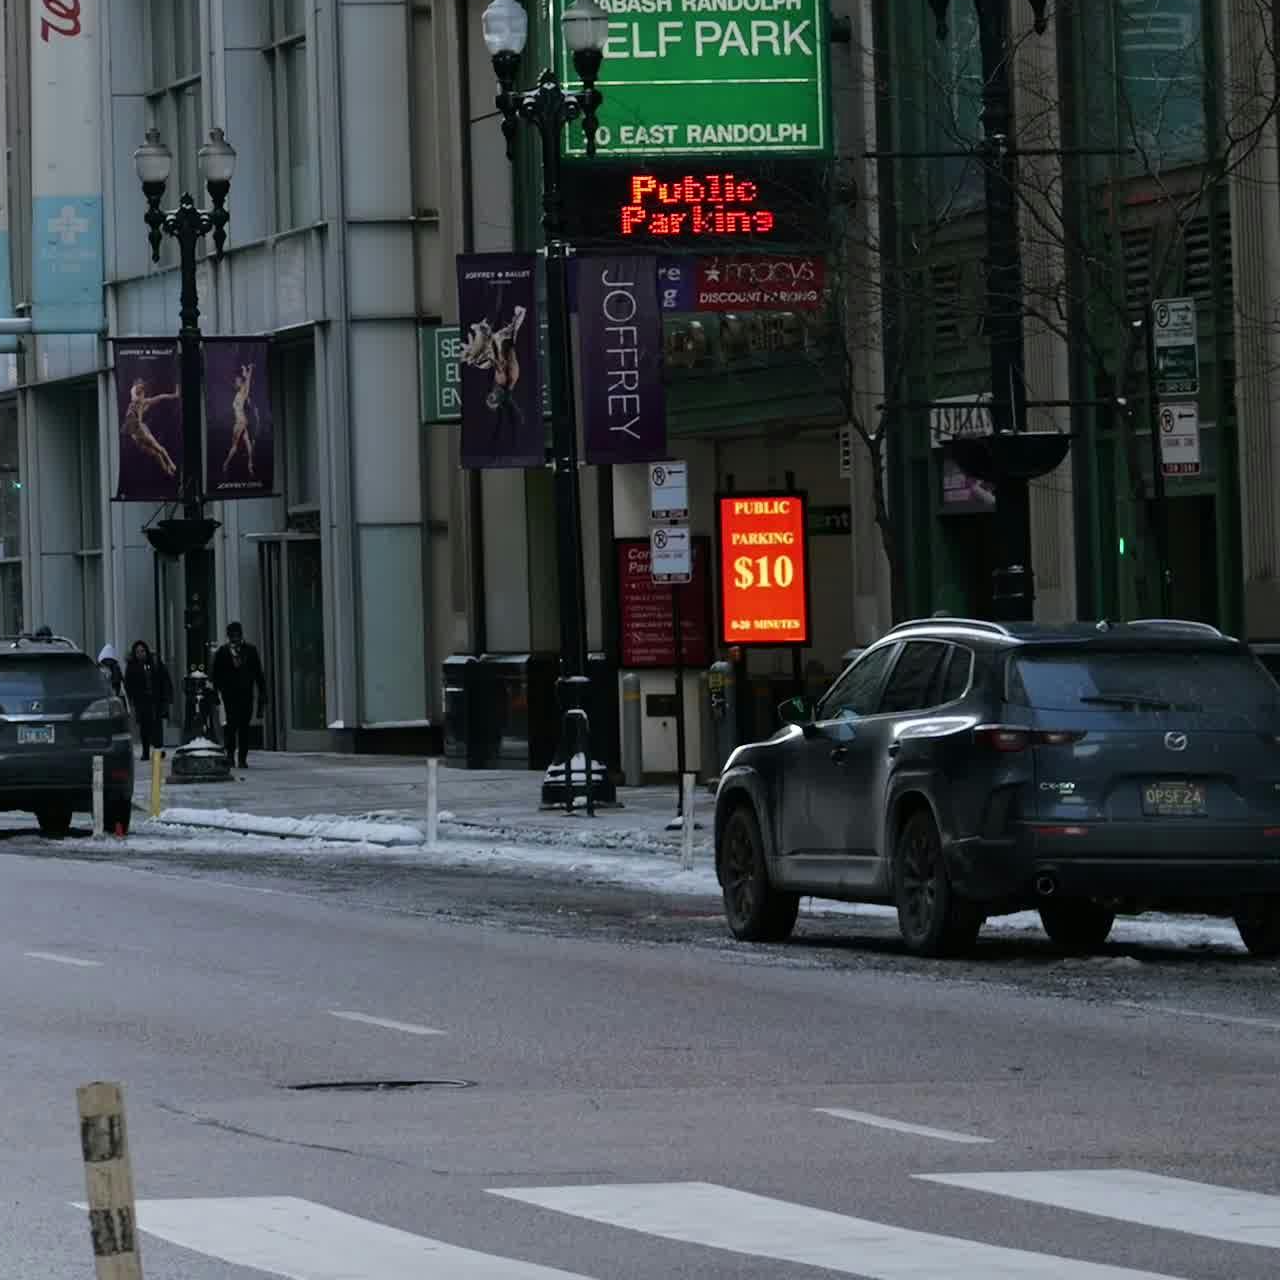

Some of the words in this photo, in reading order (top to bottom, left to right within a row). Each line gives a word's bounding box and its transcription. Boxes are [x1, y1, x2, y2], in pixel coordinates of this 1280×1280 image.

[602, 21, 684, 59] ELF
[694, 20, 813, 58] PARK
[619, 124, 679, 145] EAST
[686, 123, 808, 144] RANDOLPH
[631, 175, 757, 204] Public
[620, 204, 775, 235] Parking
[699, 289, 761, 304] DISCOUNT
[601, 269, 641, 440] JOFFREY
[734, 500, 790, 515] PUBLIC
[731, 531, 795, 545] PARKING
[733, 554, 794, 590] $10
[753, 619, 800, 629] MINUTES
